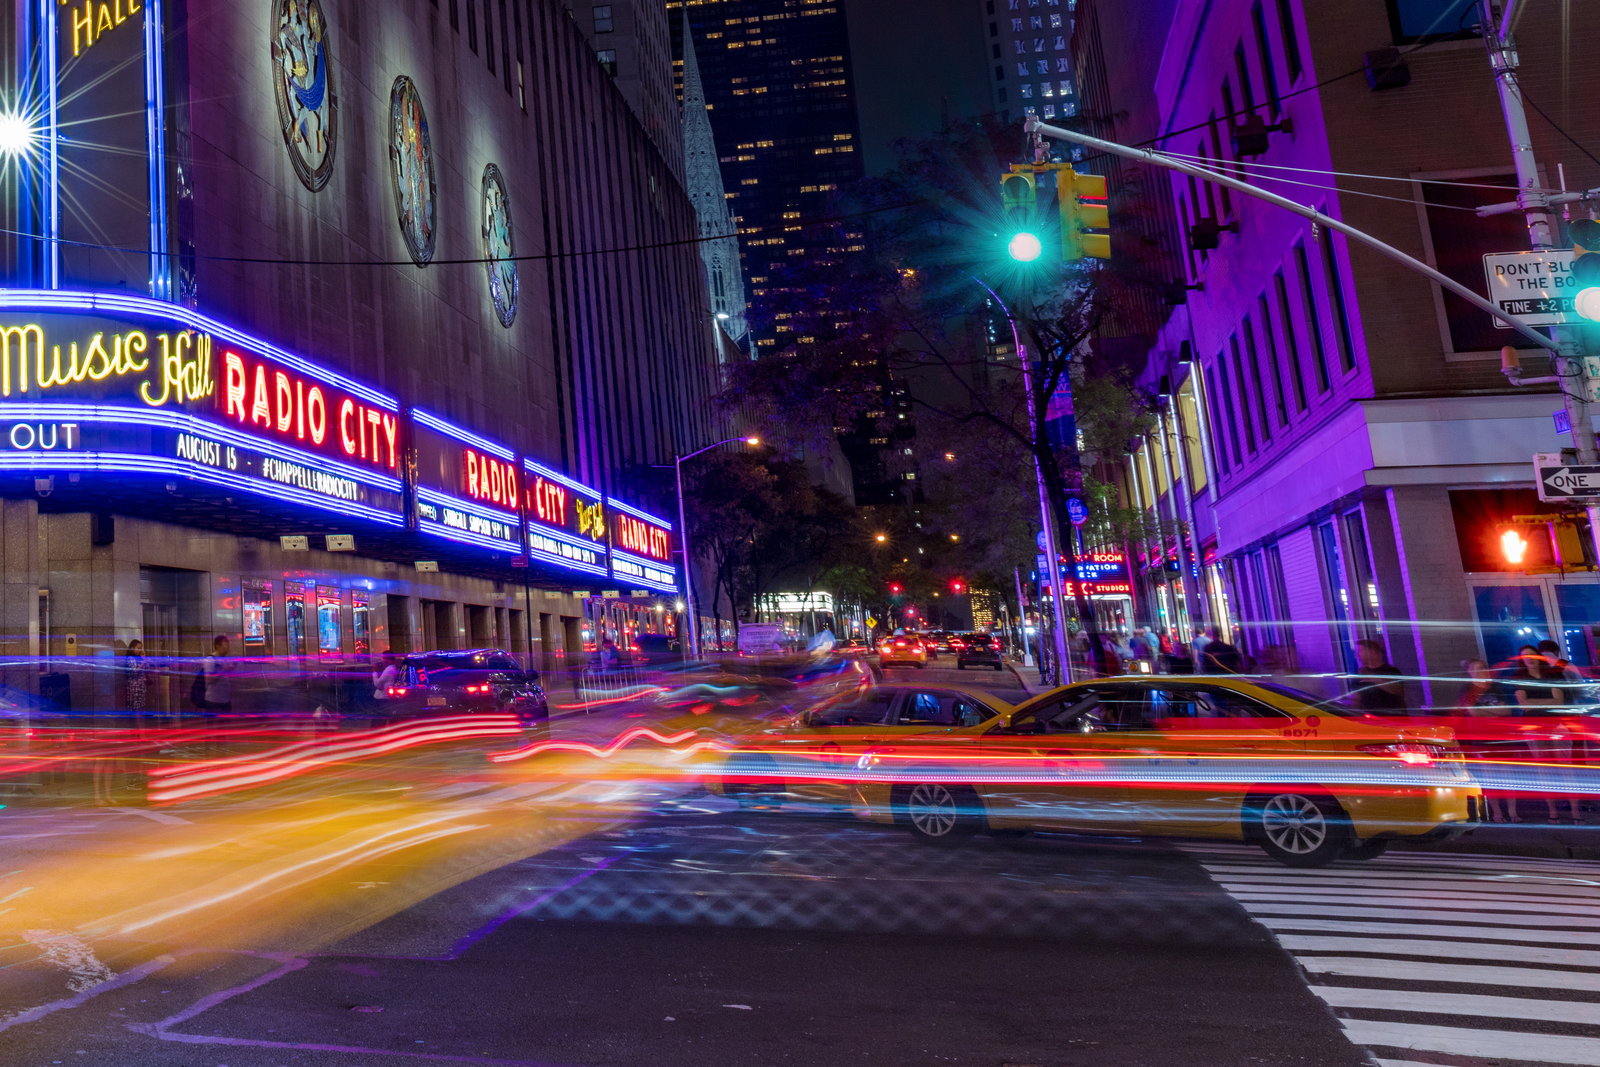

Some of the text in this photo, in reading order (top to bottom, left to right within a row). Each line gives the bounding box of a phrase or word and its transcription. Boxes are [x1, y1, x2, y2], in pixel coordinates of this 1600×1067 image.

[1495, 262, 1542, 276] DON'T
[1516, 276, 1577, 290] THE BO
[1504, 300, 1533, 314] FINE
[141, 331, 214, 407] Hall
[225, 350, 326, 445] RADIO
[341, 399, 397, 468] CITY
[9, 422, 79, 450] OUT
[176, 433, 221, 467] AUGUST
[226, 446, 237, 470] 15
[262, 457, 357, 501] #CHAPPELLERADIOCITY
[1553, 475, 1589, 488] ONE
[466, 449, 517, 509] RADIO
[535, 476, 565, 526] CITY
[621, 514, 648, 554] RADIO
[649, 525, 668, 560] CITY
[1093, 554, 1122, 562] ROOM
[1096, 584, 1130, 592] STUDIOS
